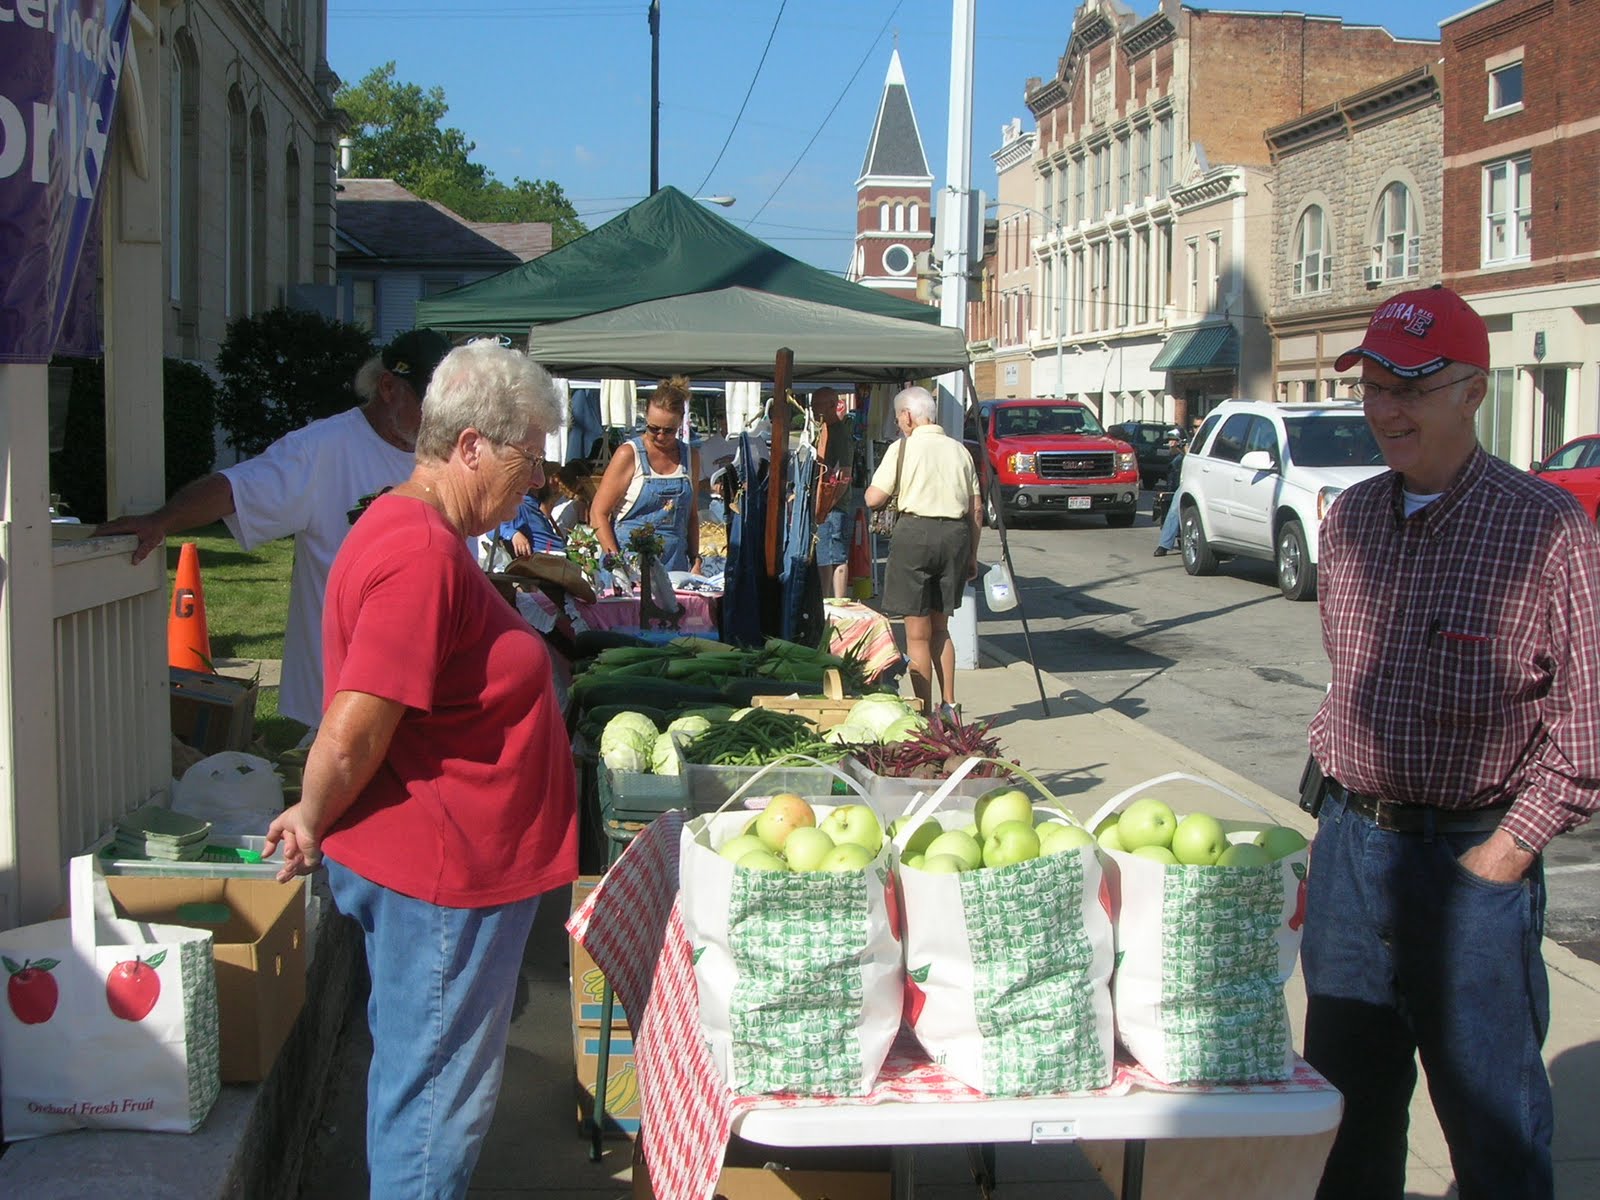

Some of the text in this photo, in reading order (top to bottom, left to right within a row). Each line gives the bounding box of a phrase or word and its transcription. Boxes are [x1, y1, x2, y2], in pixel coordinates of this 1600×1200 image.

[1404, 313, 1433, 336] E
[176, 588, 195, 618] G
[28, 1098, 154, 1115] Orchard Fresh Fruit
